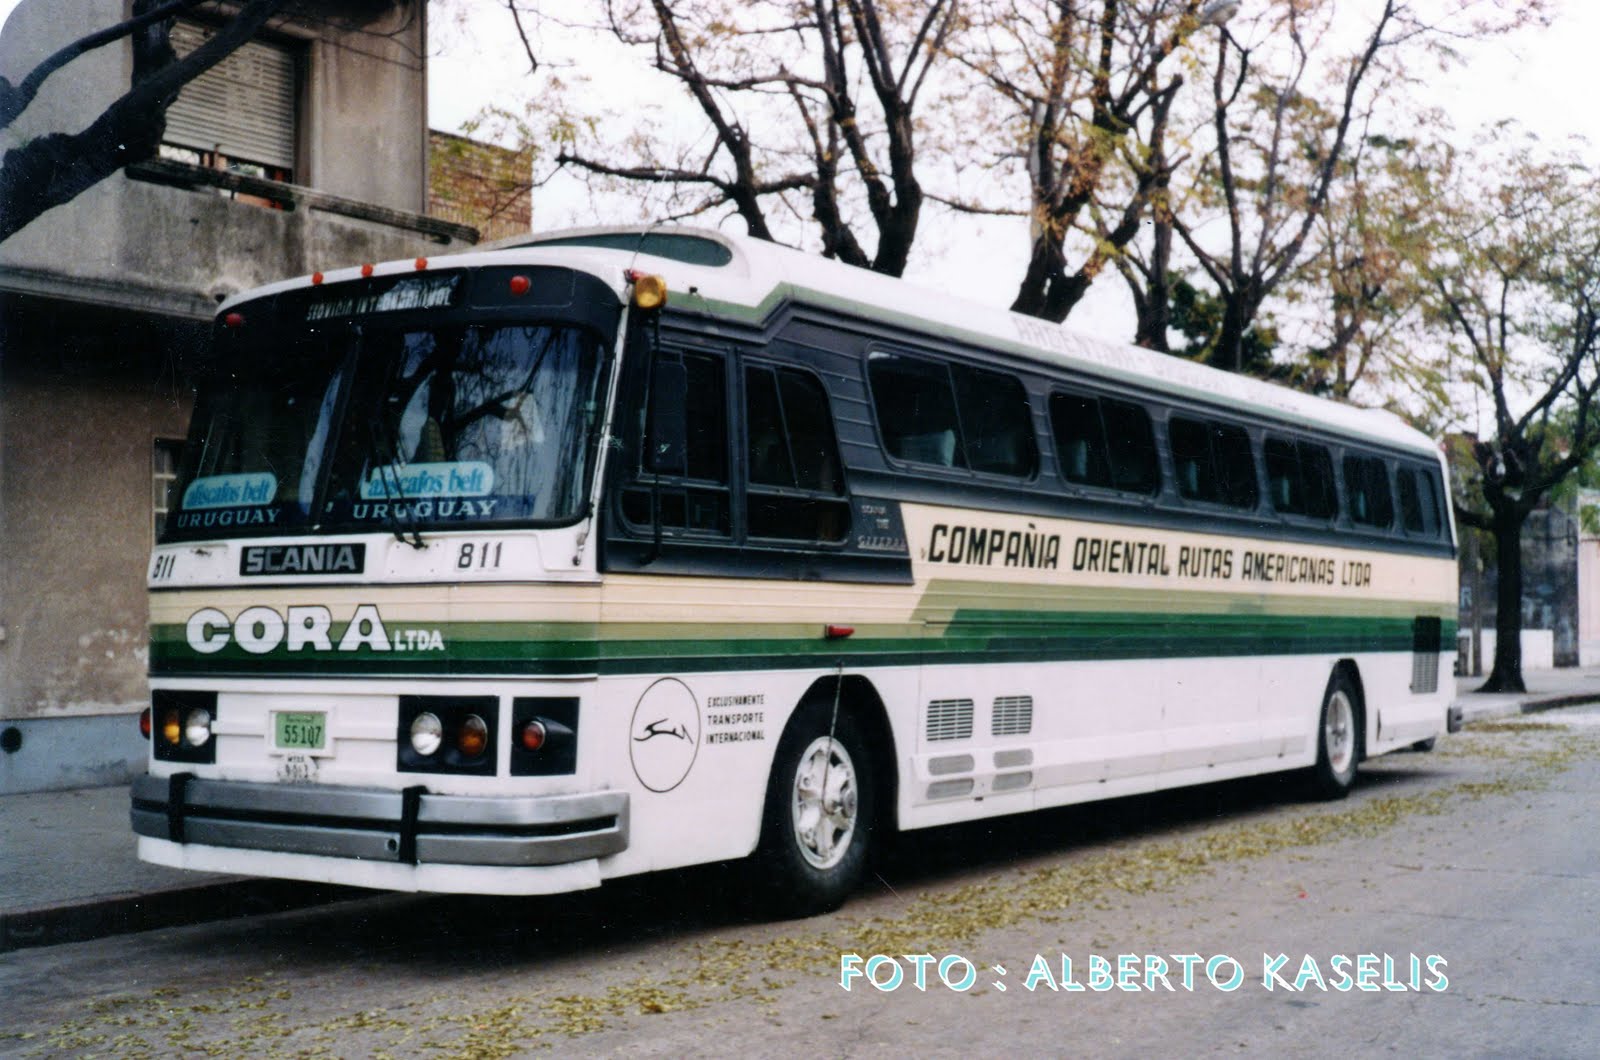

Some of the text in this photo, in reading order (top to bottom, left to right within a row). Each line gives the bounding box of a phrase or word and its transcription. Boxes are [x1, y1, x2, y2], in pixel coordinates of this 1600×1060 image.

[177, 508, 281, 529] URUGUAY
[352, 499, 498, 519] URUGUAY
[153, 555, 176, 580] 811
[246, 545, 356, 573] SCANIA
[457, 542, 503, 571] 811
[1073, 536, 1170, 576] ORIENTAL
[1177, 545, 1234, 581] RUTAS
[1241, 551, 1336, 587] AMERICANAS
[1341, 559, 1373, 589] LTDA
[185, 603, 446, 655] CORA LTDA
[707, 712, 765, 726] TRANSPORTE
[705, 730, 765, 745] INTERNACIONAL
